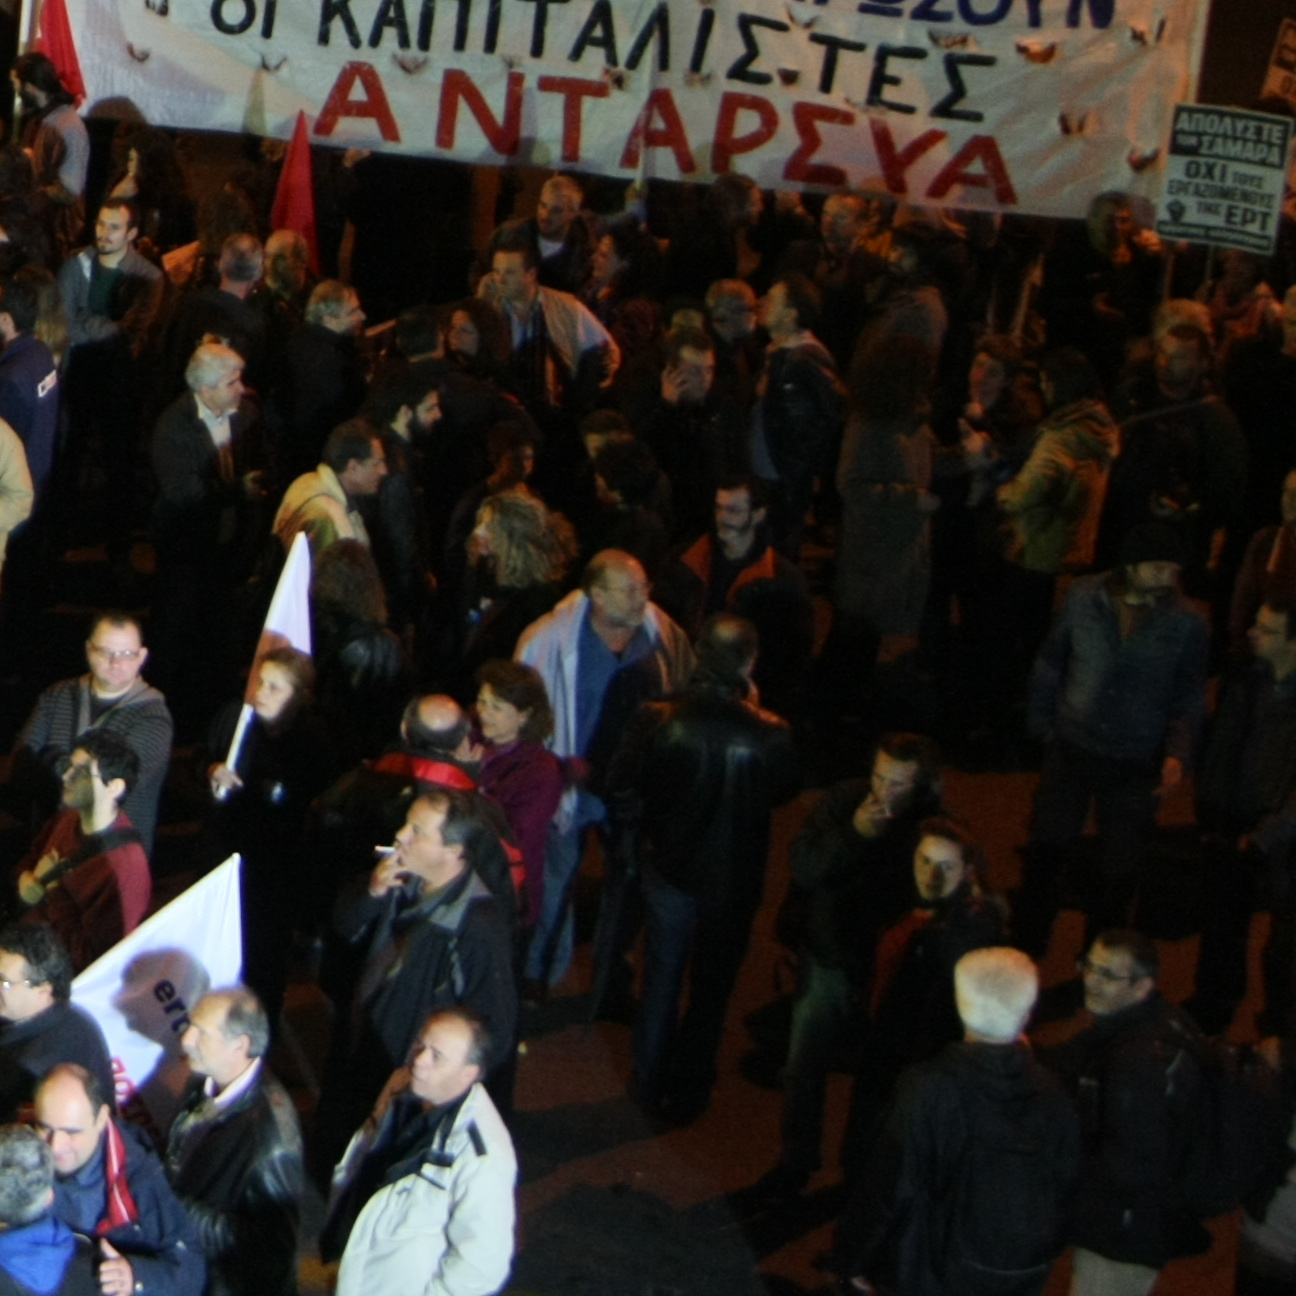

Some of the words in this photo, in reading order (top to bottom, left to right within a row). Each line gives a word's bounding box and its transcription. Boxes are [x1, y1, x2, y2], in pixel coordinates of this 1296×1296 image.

[312, 60, 1018, 205] ΑΝΤΑΡΣΥΑ
[1175, 111, 1285, 144] ΑΠΟΛΥΣΤΕ
[1200, 136, 1281, 166] ΣΑΜΑΡΑ
[1184, 159, 1228, 183] ΟΧΙ
[1225, 204, 1272, 232] ΕΡΤ
